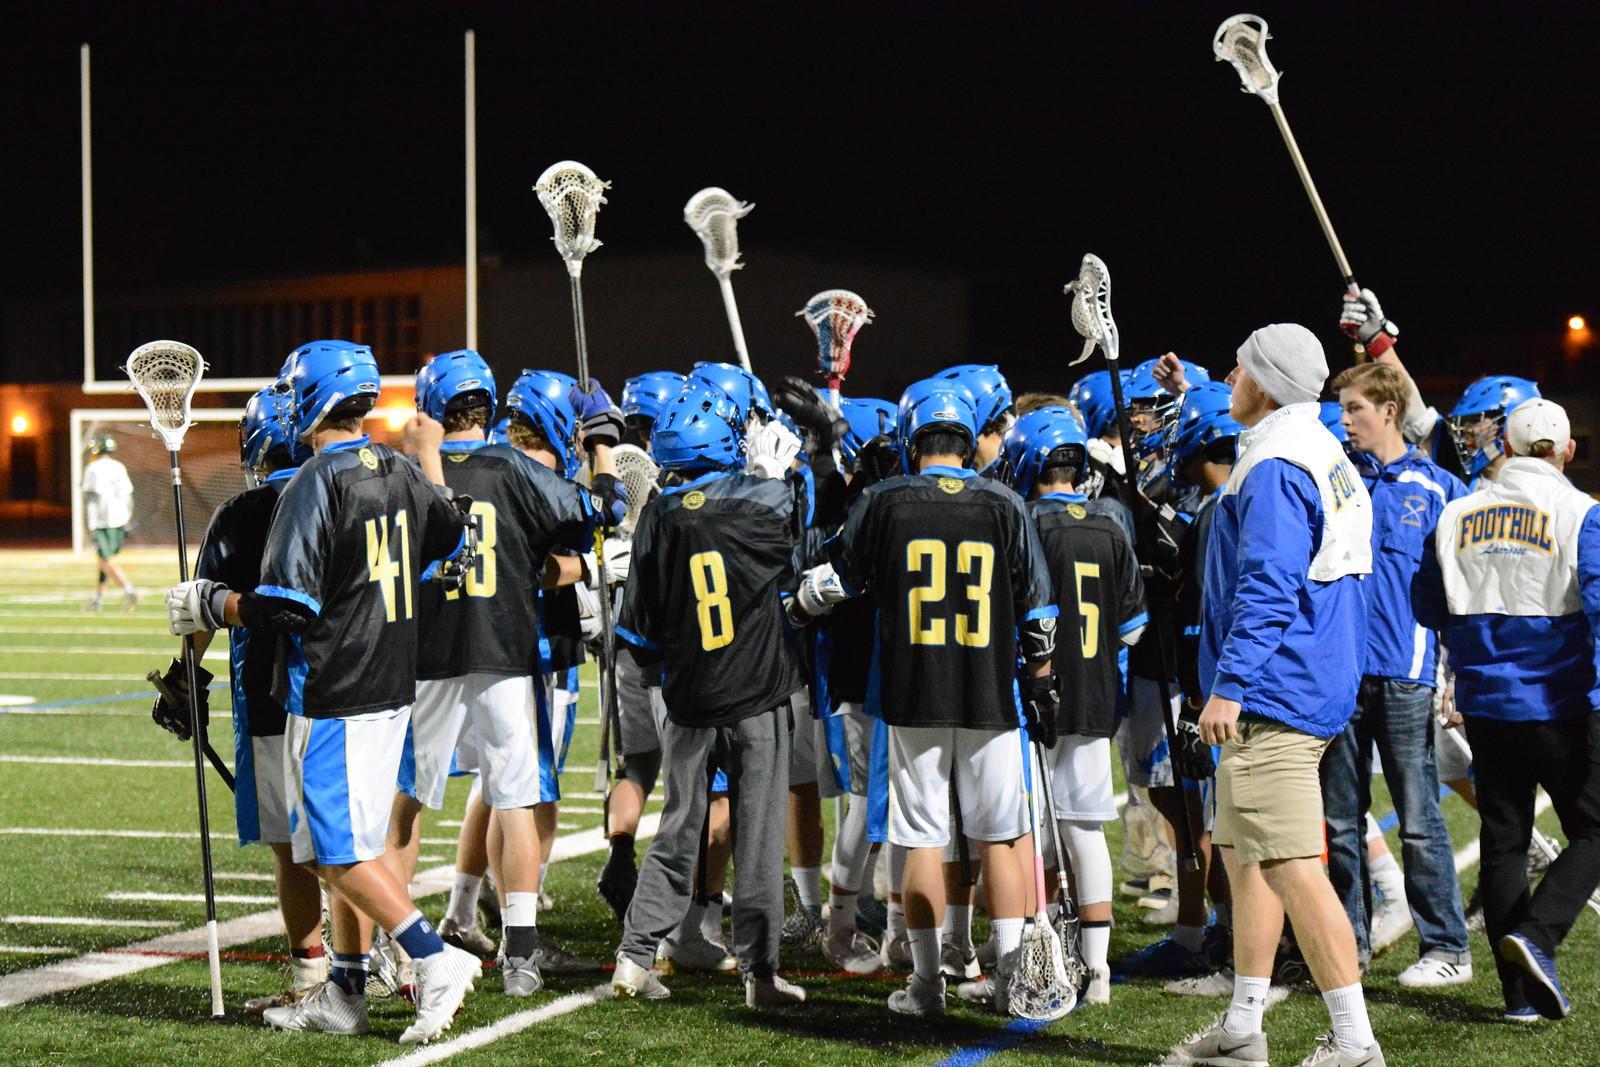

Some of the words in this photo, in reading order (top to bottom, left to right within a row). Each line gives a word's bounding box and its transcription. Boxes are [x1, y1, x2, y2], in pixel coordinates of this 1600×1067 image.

[365, 509, 413, 623] 41
[445, 500, 497, 601] 3
[1457, 504, 1553, 556] FOOTHILL
[689, 550, 735, 652] 8
[907, 539, 995, 649] 23
[1074, 562, 1100, 659] 5
